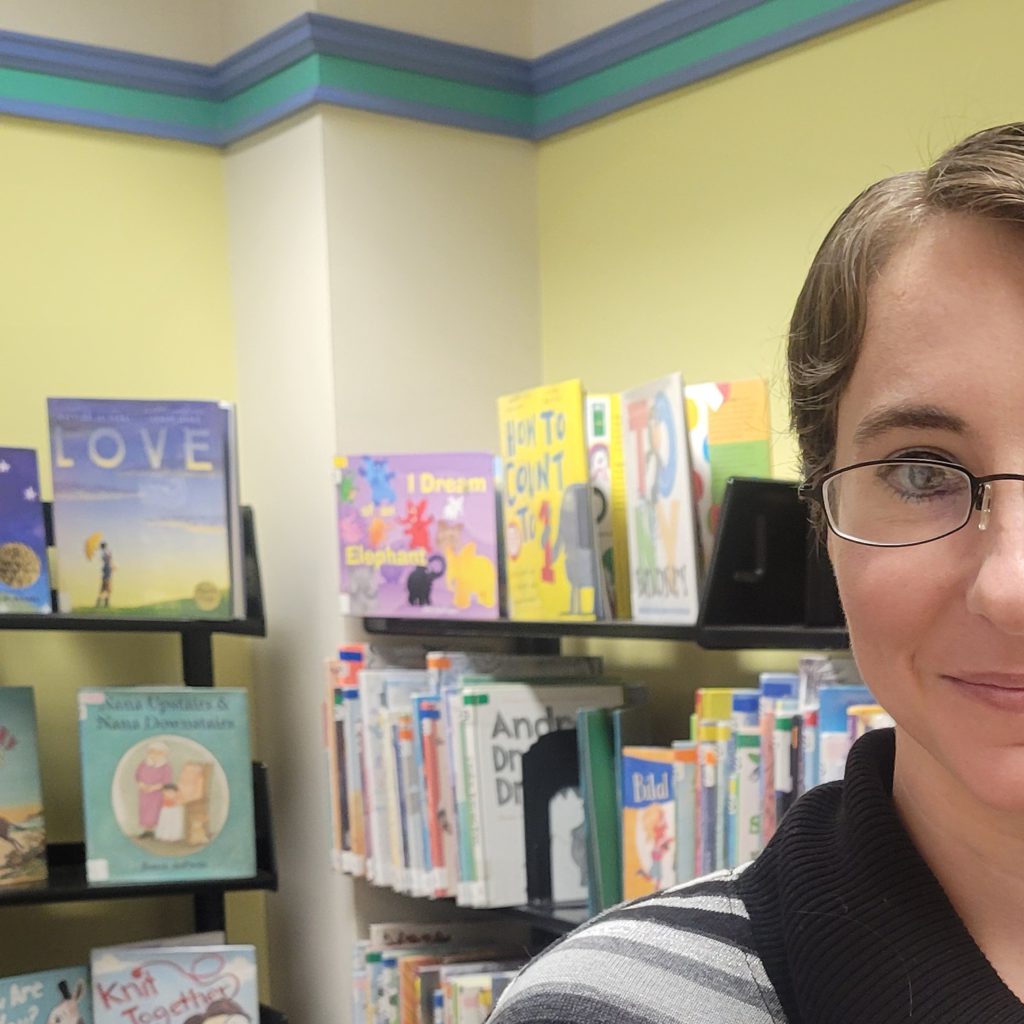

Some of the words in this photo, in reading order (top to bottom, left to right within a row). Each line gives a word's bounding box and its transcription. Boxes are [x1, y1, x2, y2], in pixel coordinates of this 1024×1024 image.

[54, 427, 214, 471] LOVE
[507, 413, 536, 457] HOW
[541, 410, 565, 445] TO
[407, 475, 414, 493] I
[420, 472, 487, 493] Dream
[507, 452, 564, 506] COUNT
[345, 545, 427, 570] Elephant
[631, 771, 669, 802] Bilal
[96, 970, 159, 1010] Knit
